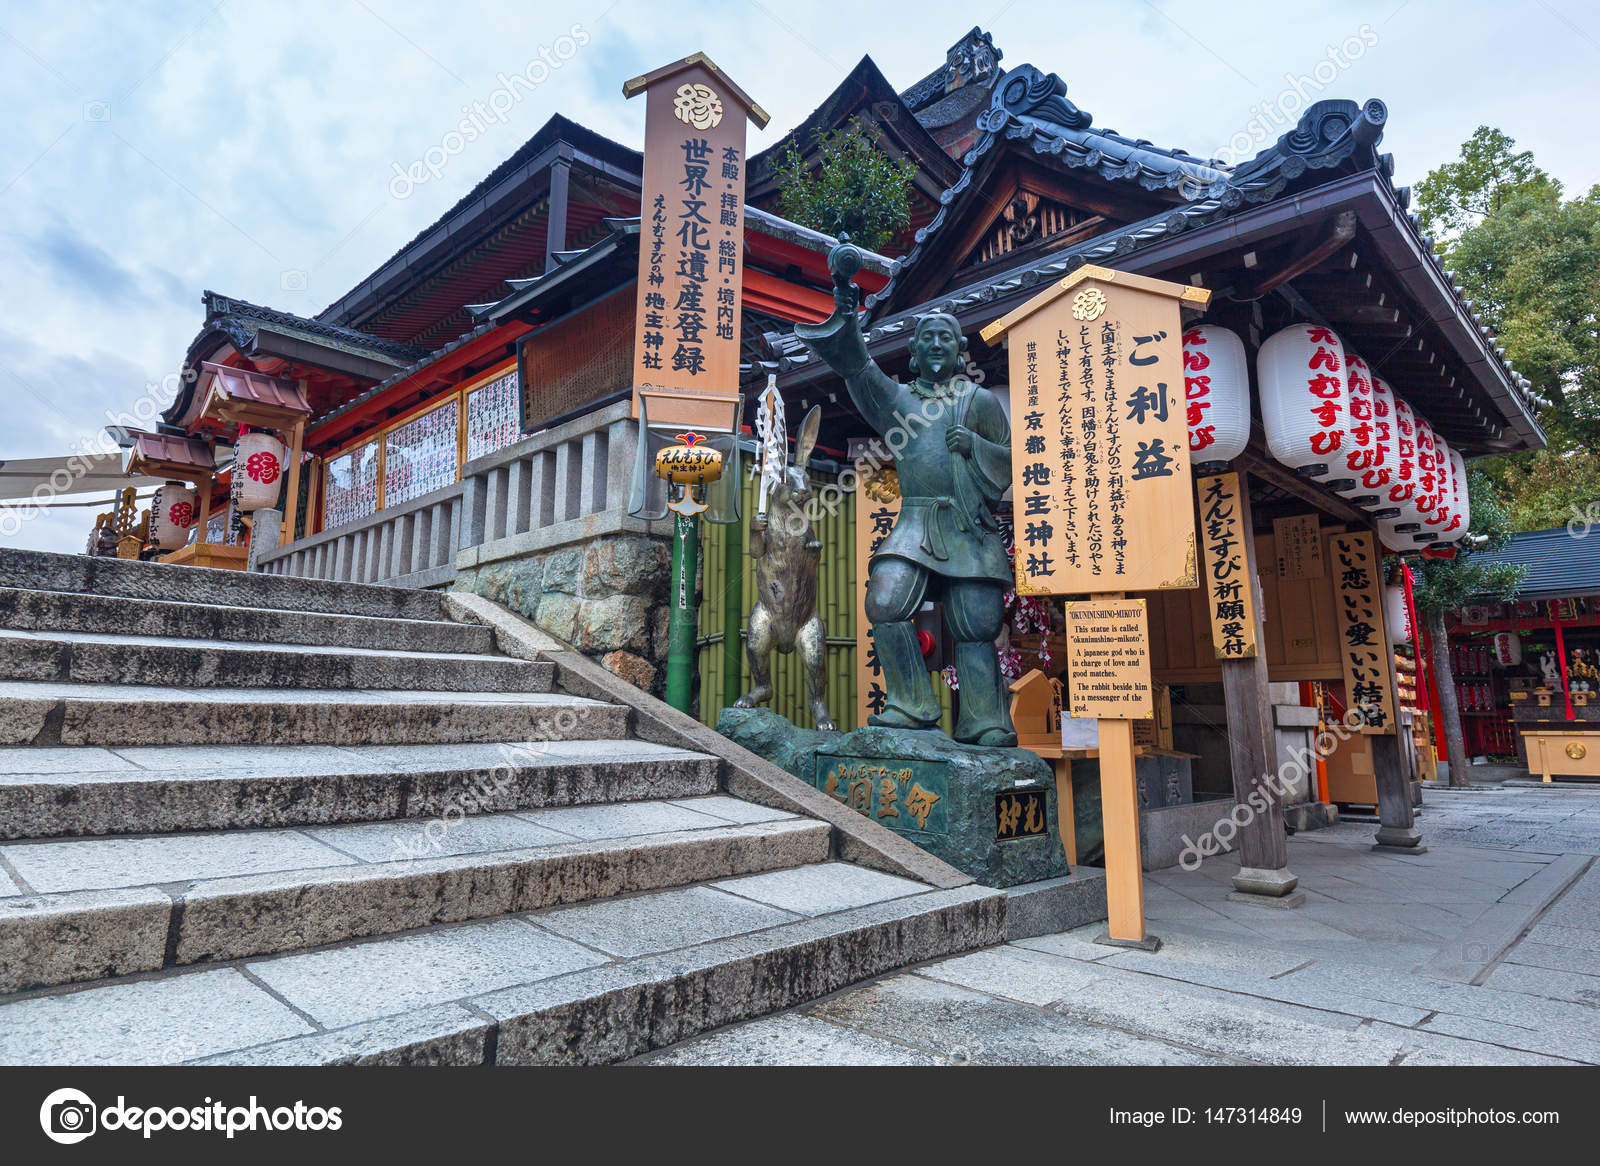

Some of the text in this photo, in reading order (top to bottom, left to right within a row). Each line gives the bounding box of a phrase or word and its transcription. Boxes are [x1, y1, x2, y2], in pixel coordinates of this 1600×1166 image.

[641, 194, 667, 371] えんむすびの神 地主神社
[671, 138, 714, 376] 世界文化遺産登録
[715, 146, 740, 341] 本殿・拝殿・総門・境内地
[661, 449, 715, 465] えんむすび
[1022, 341, 1056, 578] 世界文化遺産 京都地主神社
[1056, 329, 1081, 569] しい神さまでみんなに幸福を与えて下さいます。
[1101, 321, 1128, 575] 大国主命さまはえんむすびのご利益がある神さま
[1126, 330, 1174, 481] ご利益
[1307, 326, 1346, 456] えんむすび
[1074, 624, 1139, 633] This statue is called
[1204, 478, 1247, 656] えんむすび祈願受付
[1337, 537, 1387, 729] いい恋いい愛いい結婚
[1072, 659, 1078, 667] in
[1080, 659, 1101, 668] charge
[1103, 659, 1110, 667] of
[1127, 658, 1139, 666] and
[1072, 670, 1087, 678] good
[1073, 693, 1079, 701] is
[1122, 693, 1129, 701] of
[1131, 693, 1142, 701] the
[1074, 704, 1088, 712] god.
[1077, 682, 1148, 690] The rabbit beside him
[1083, 649, 1109, 657] japanese
[1111, 648, 1122, 657] god
[1125, 648, 1137, 656] who
